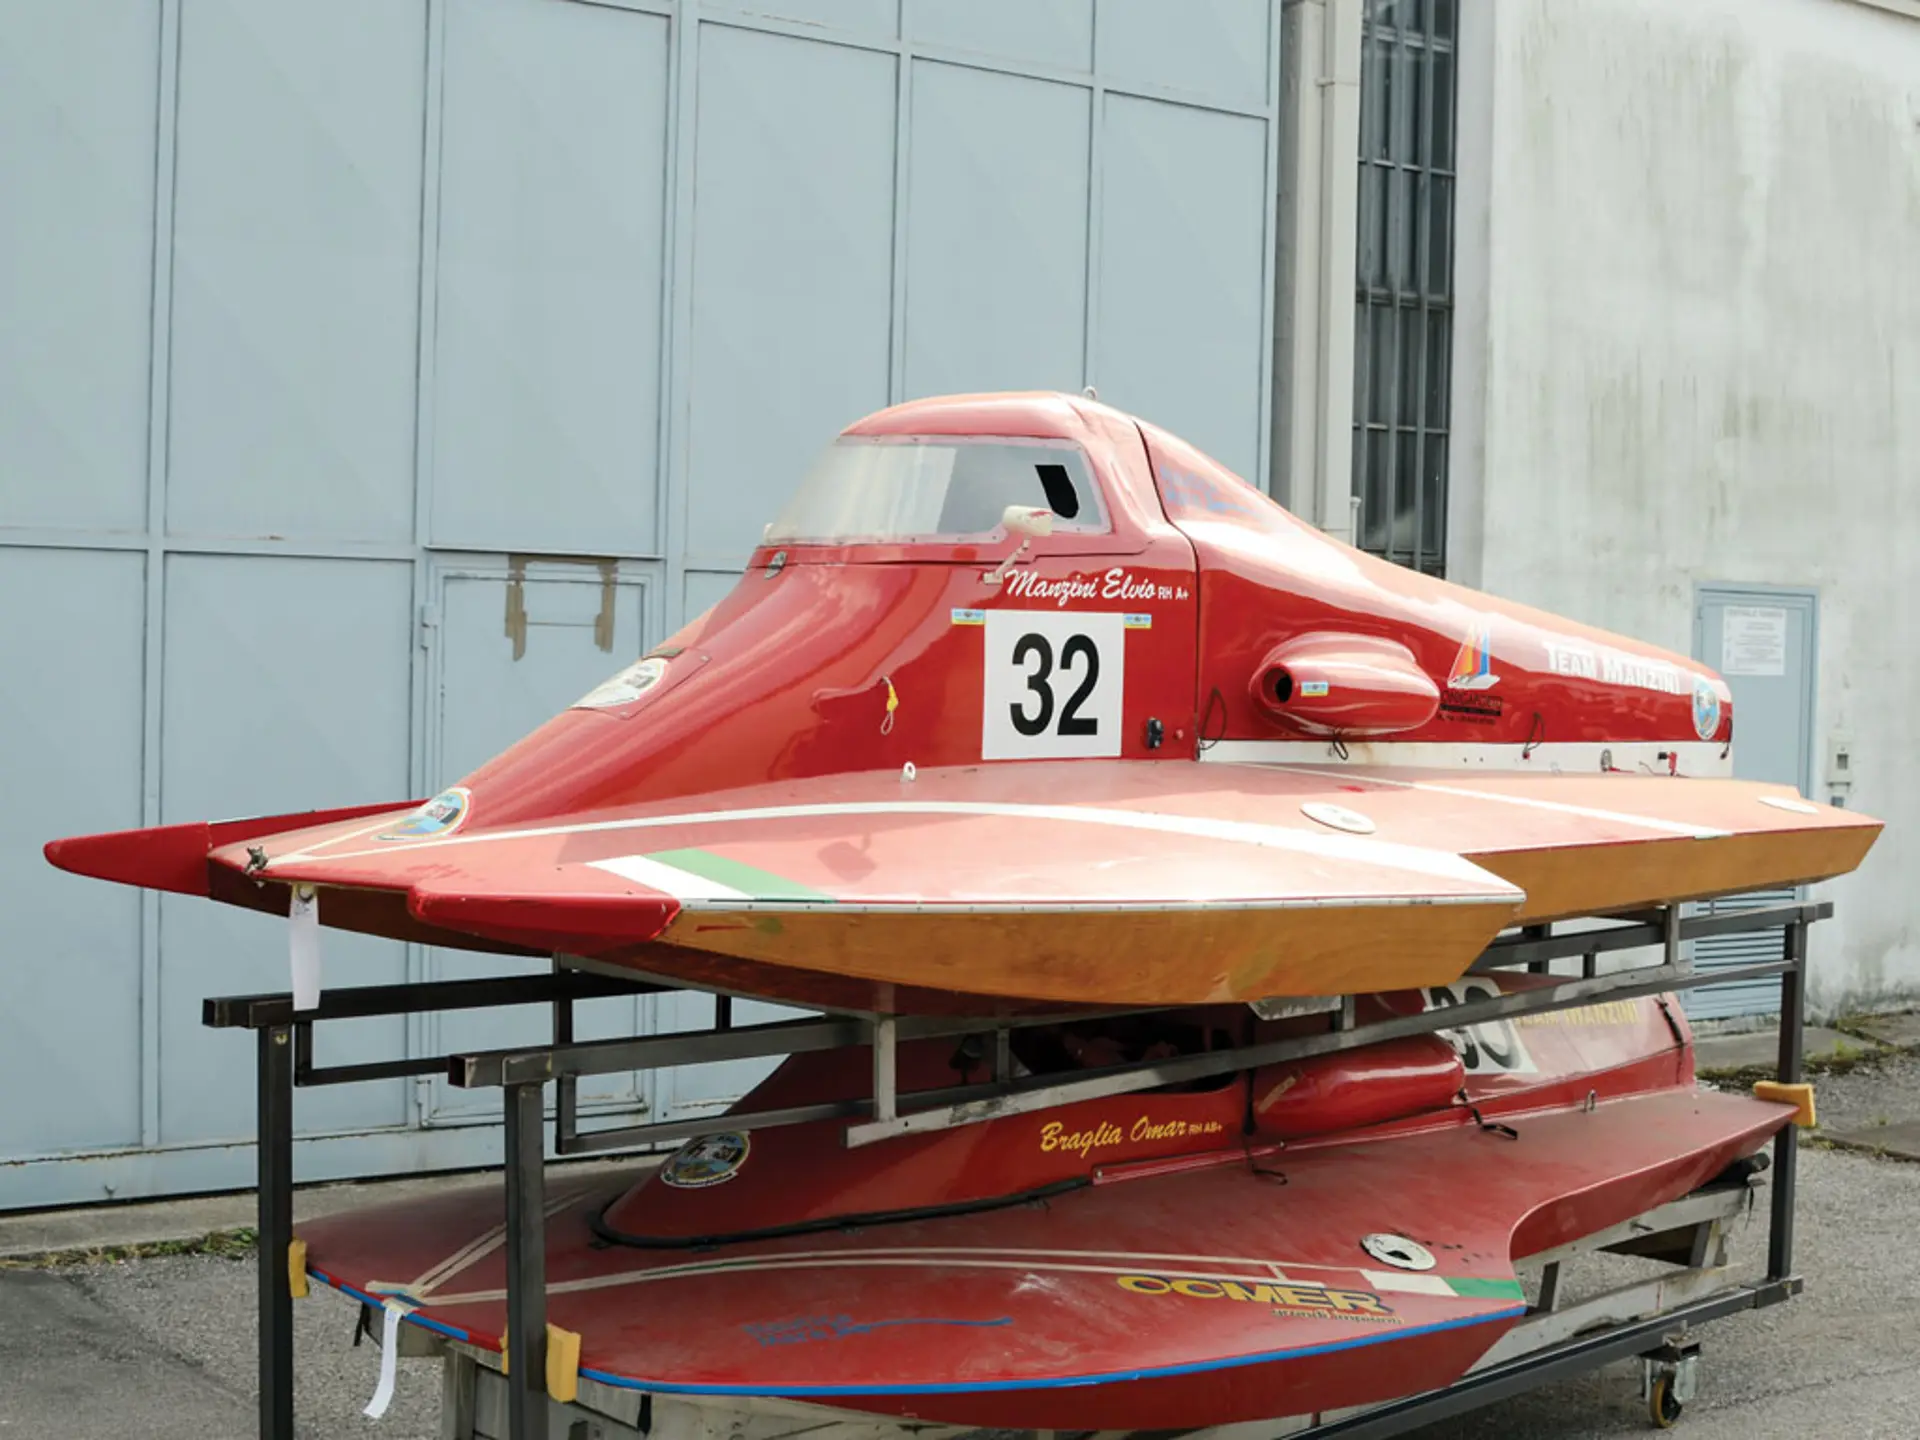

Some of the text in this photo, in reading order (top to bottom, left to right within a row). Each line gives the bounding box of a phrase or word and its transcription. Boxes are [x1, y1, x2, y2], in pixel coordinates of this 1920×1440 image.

[1004, 567, 1188, 606] Manzini Elvio RH A+
[1009, 633, 1100, 736] 32
[1040, 1121, 1123, 1159] Braglia
[1130, 1116, 1186, 1143] Omar
